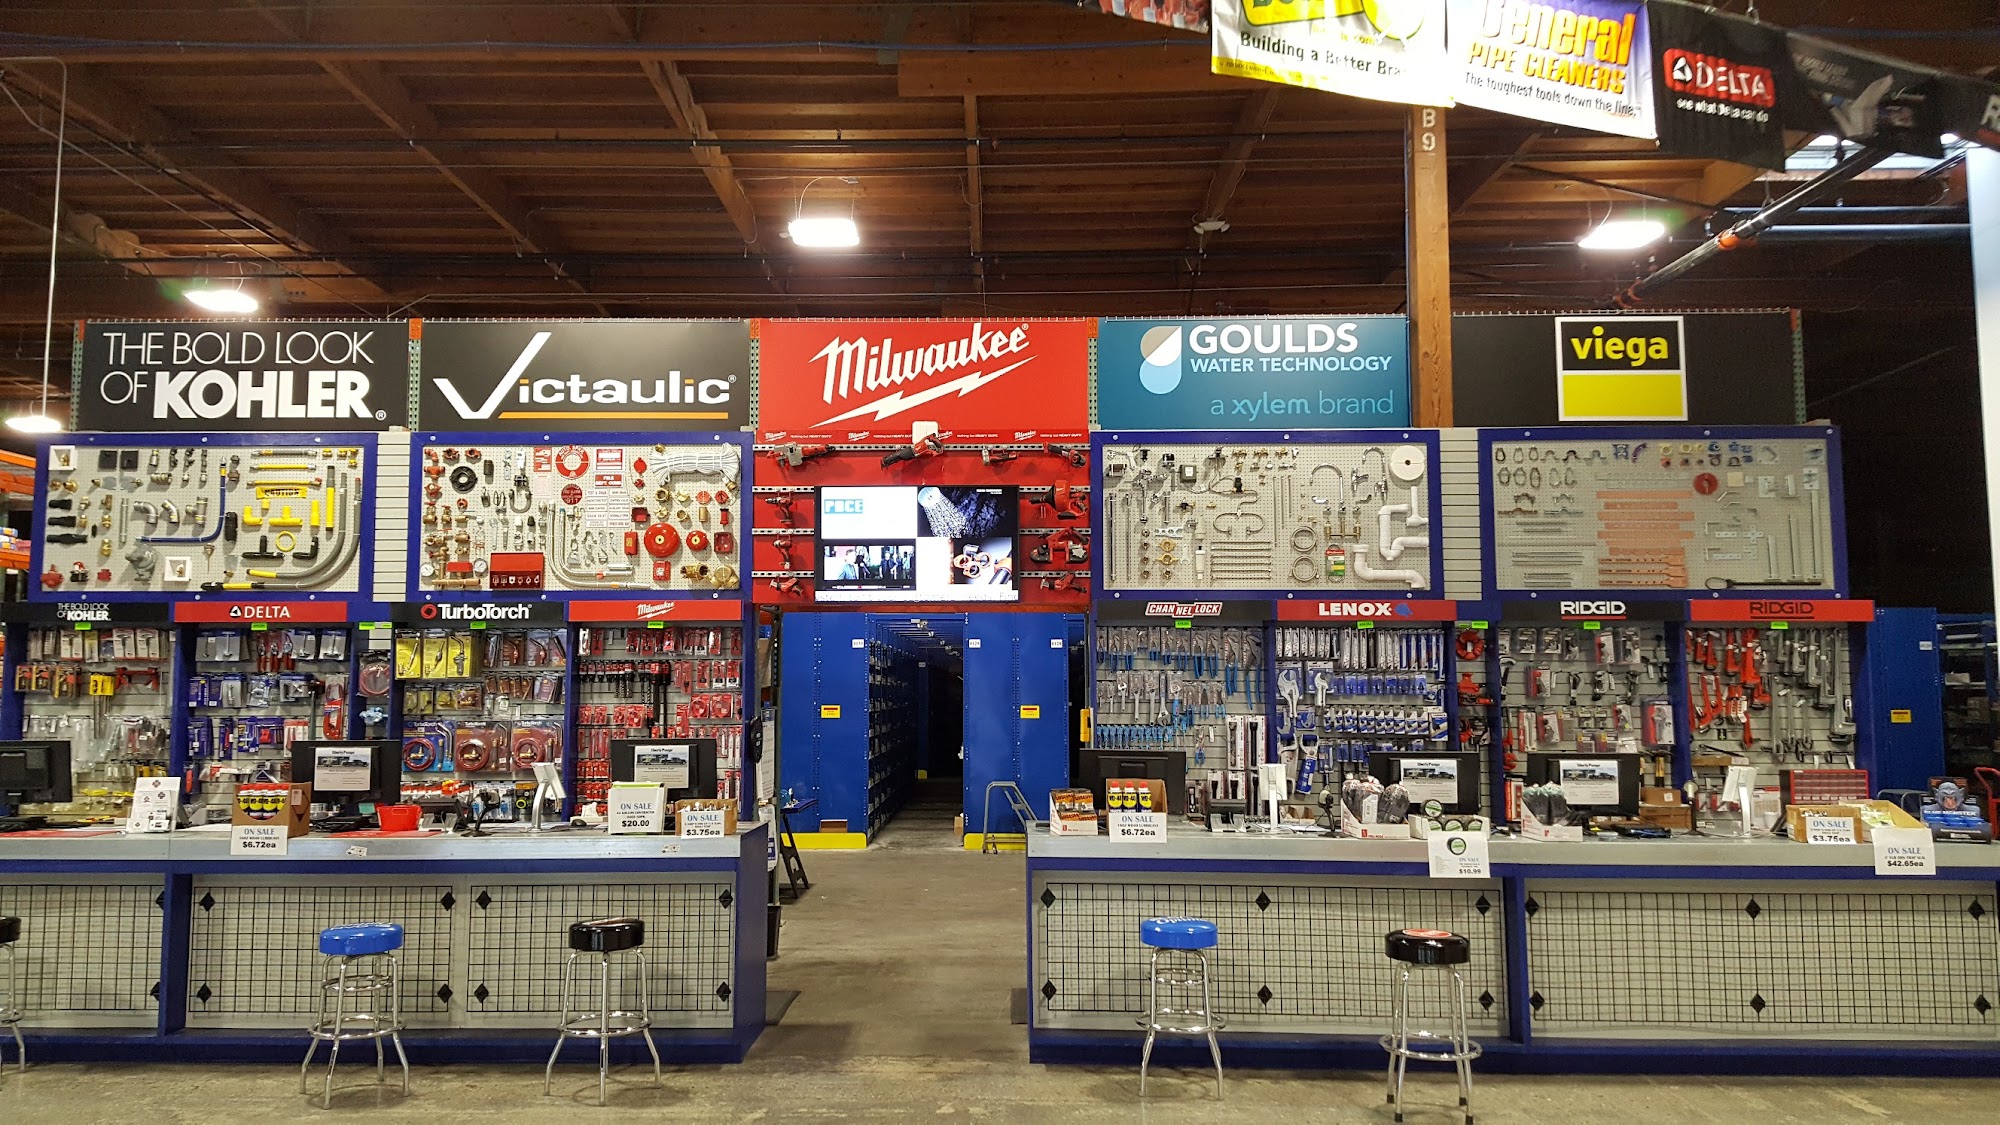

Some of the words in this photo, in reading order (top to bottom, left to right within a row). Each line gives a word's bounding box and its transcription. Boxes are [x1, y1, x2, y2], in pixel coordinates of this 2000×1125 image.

[1241, 31, 1304, 63] Building
[1310, 50, 1319, 62] a
[1468, 42, 1518, 73] PIPE
[1522, 53, 1627, 94] CLEANERS
[1695, 60, 1770, 98] DELTA
[1465, 72, 1484, 87] The
[1486, 77, 1534, 98] toughest
[1536, 87, 1561, 103] tools
[1564, 94, 1592, 109] down
[1595, 97, 1612, 113] the
[103, 332, 164, 365] THE
[172, 331, 266, 365] BOLD
[275, 331, 374, 365] LOOK
[1189, 323, 1359, 355] GOULDS
[1571, 326, 1669, 367] viega
[433, 332, 730, 419] Victaulic
[808, 322, 1030, 405] Milwaukee
[1190, 357, 1254, 373] WATER
[1259, 356, 1392, 373] TECHNOLOGY
[100, 371, 149, 405] OF
[153, 370, 374, 419] KOHLER
[1210, 399, 1224, 416] a
[1231, 391, 1311, 422] xylem
[1319, 390, 1394, 416] brand
[57, 602, 70, 611] THE
[70, 602, 89, 611] BOLD
[90, 602, 110, 611] LOOK
[57, 610, 67, 618] OF
[66, 610, 109, 621] KOHLER
[244, 605, 291, 618] DELTA
[438, 603, 529, 620] TurboTorch
[636, 601, 675, 617] Milwaukee
[1318, 602, 1391, 616] LENOX
[1560, 601, 1627, 615] RIDGID
[1749, 601, 1815, 614] RIDGID
